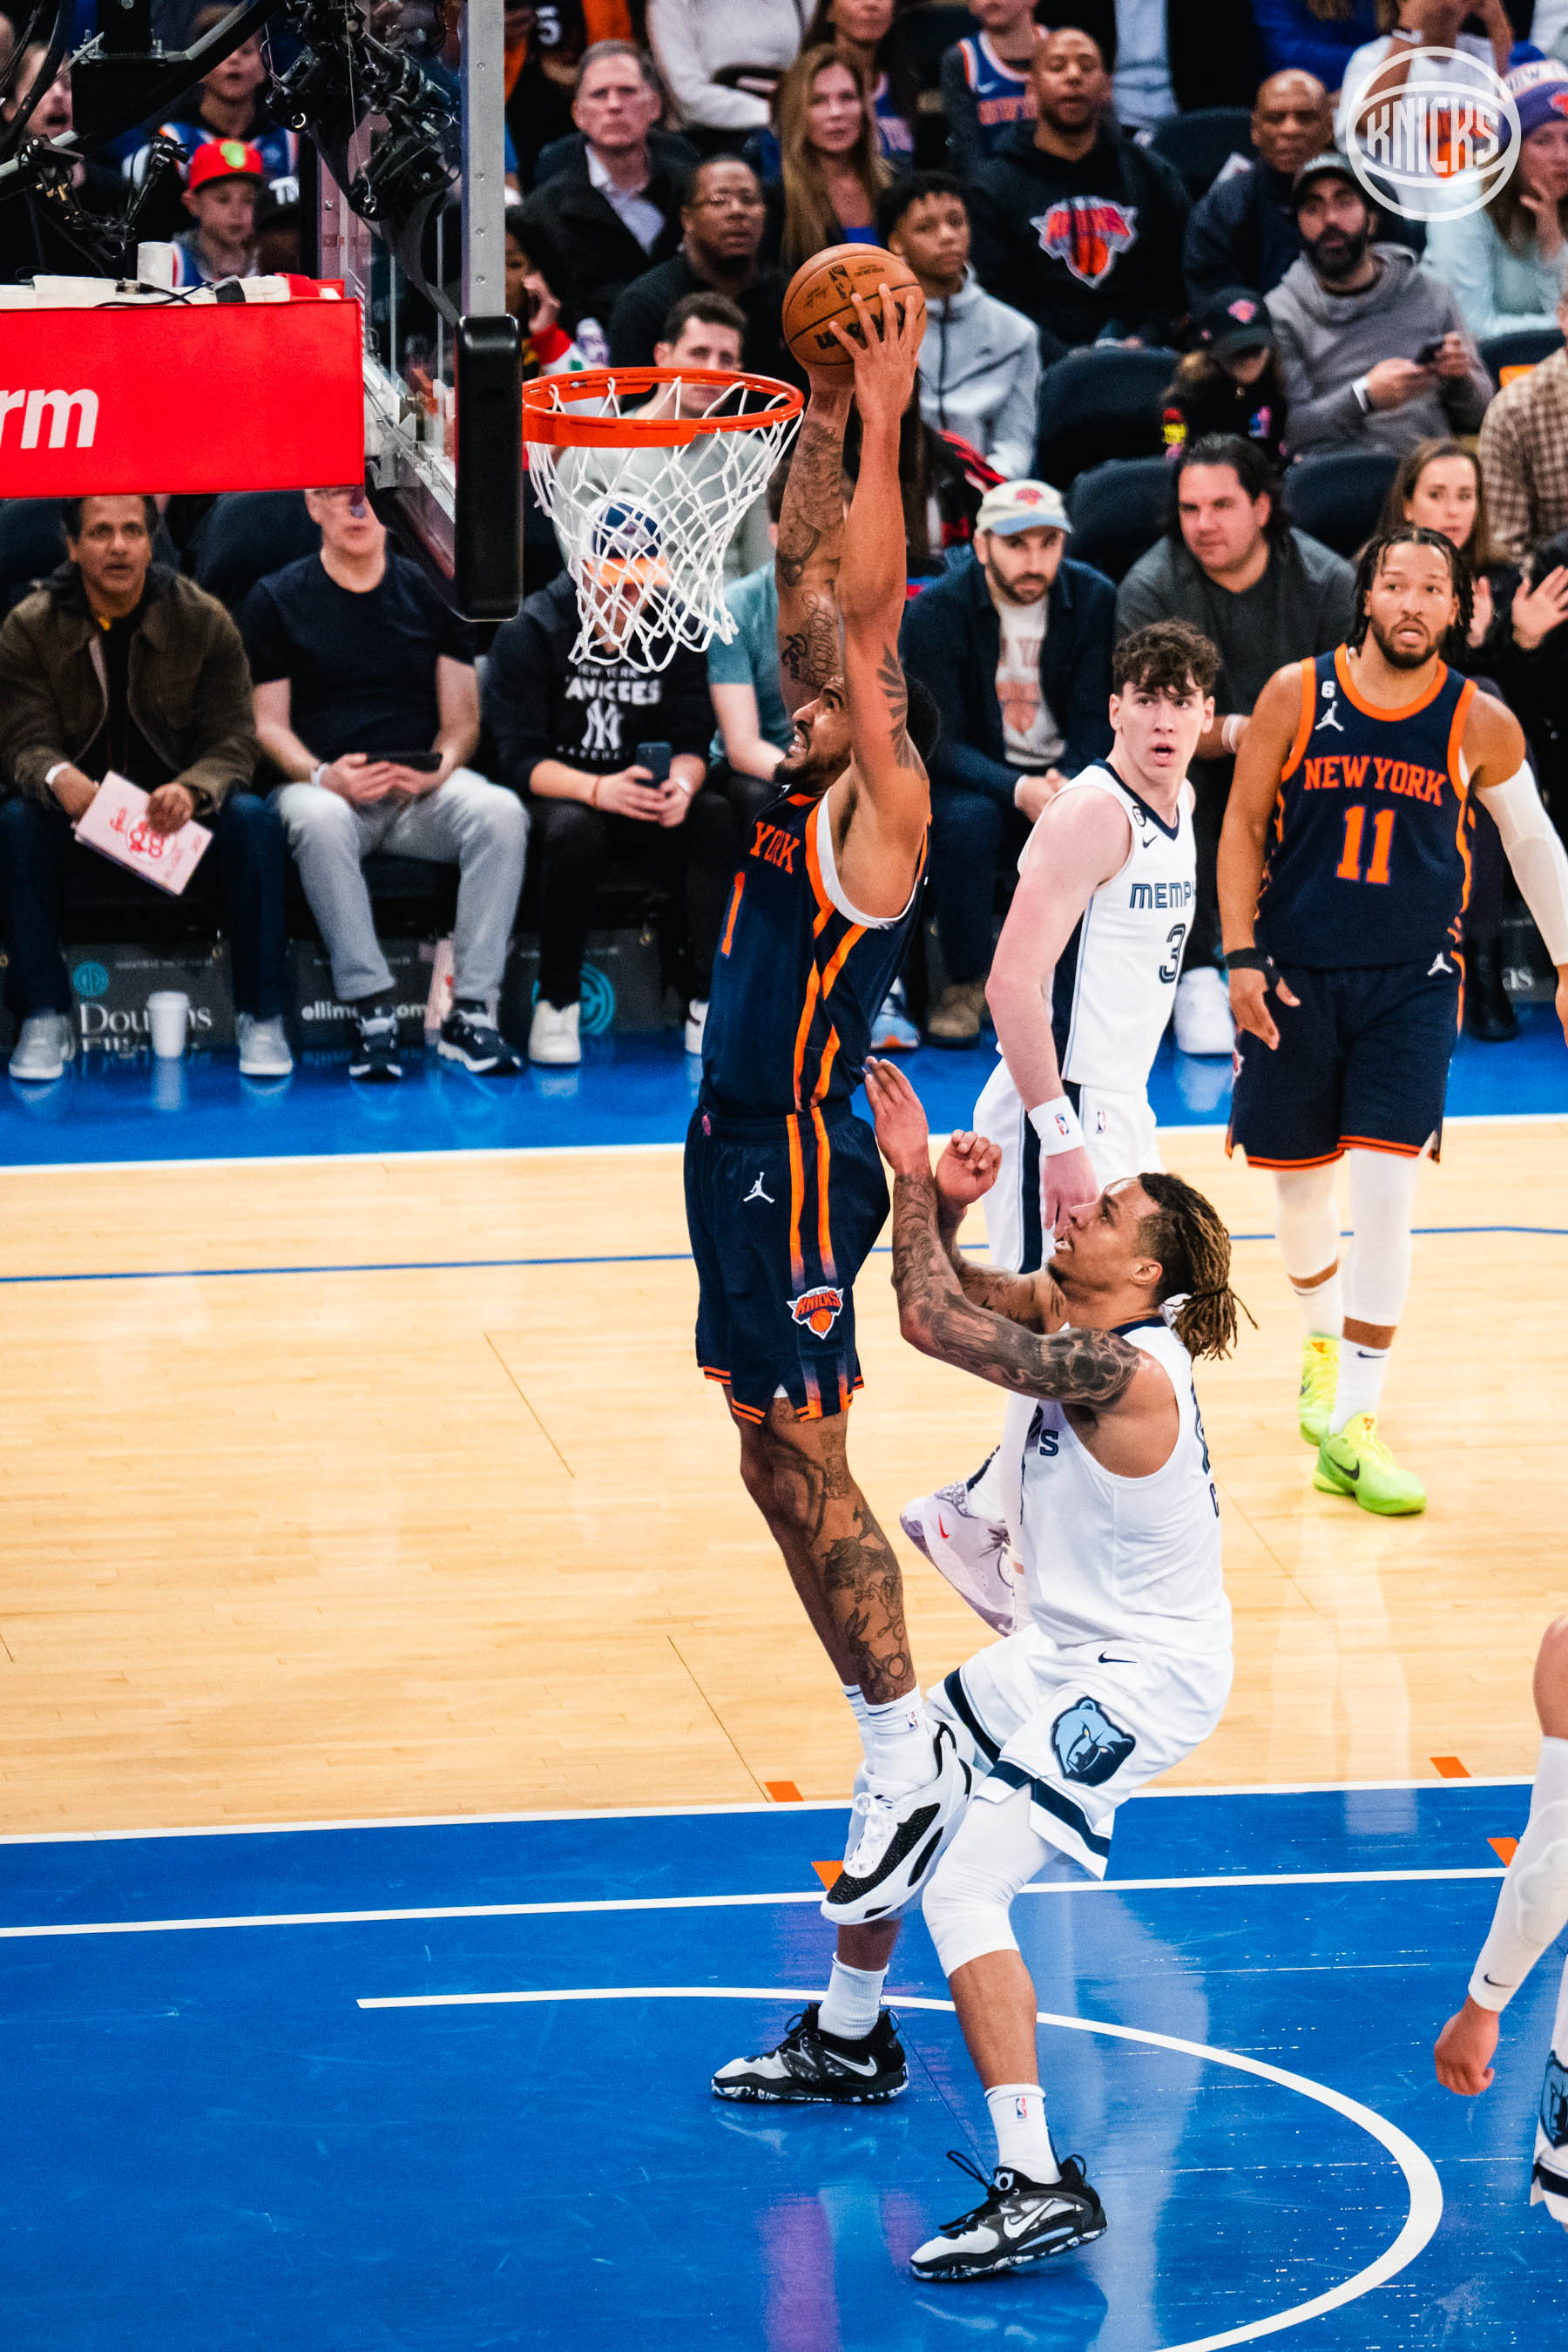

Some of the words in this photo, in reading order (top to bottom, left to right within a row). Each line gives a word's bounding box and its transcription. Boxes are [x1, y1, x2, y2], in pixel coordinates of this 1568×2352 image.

[564, 676, 661, 705] ANKEES
[1321, 680, 1336, 699] 6
[1304, 755, 1370, 791] NEW
[1373, 755, 1448, 807] YORK
[1335, 805, 1396, 885] 11
[720, 871, 746, 956] 1
[1158, 923, 1186, 984] 3
[80, 1002, 213, 1035] Dous
[794, 1289, 842, 1318] KNICKS
